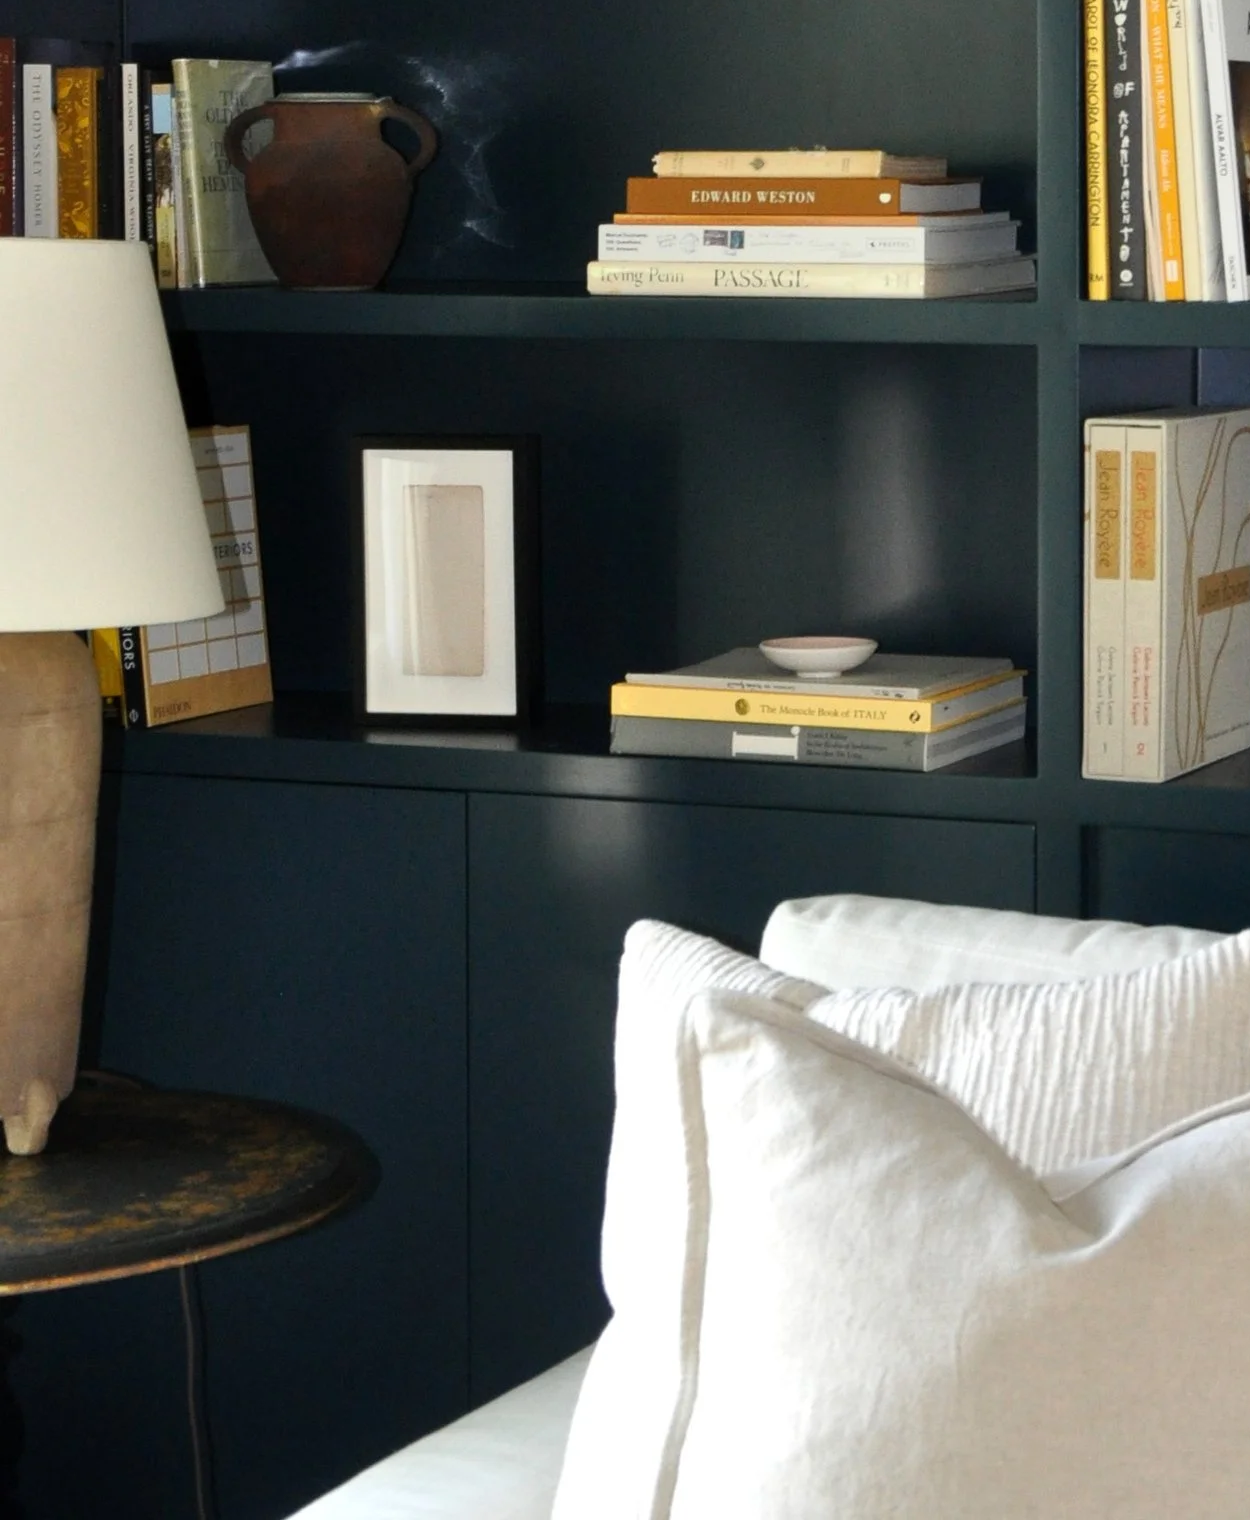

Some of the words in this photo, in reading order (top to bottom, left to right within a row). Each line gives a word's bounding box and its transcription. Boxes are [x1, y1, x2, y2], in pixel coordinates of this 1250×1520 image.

[1087, 36, 1099, 53] OF
[1152, 26, 1164, 61] WHAT
[31, 72, 42, 102] THE
[1087, 59, 1099, 127] LEONORA
[1154, 65, 1165, 86] SHE
[1156, 88, 1168, 129] MEANS
[32, 110, 42, 180] ODYSSEY
[1215, 113, 1226, 142] ALVAR
[1217, 144, 1228, 177] AALTO
[1087, 130, 1101, 227] CARRINGTON
[33, 184, 42, 228] HOMER
[690, 190, 752, 204] EDWARD
[756, 190, 816, 204] WESTON
[600, 267, 643, 286] Irving
[648, 267, 684, 282] Penn
[713, 268, 809, 288] PASSAGE
[1098, 459, 1119, 502] Jean
[1134, 459, 1154, 503] Jean
[1095, 509, 1119, 568] Royère
[1133, 510, 1154, 569] Royère
[760, 704, 776, 715] The
[817, 707, 838, 718] Book
[853, 709, 887, 721] ITALY
